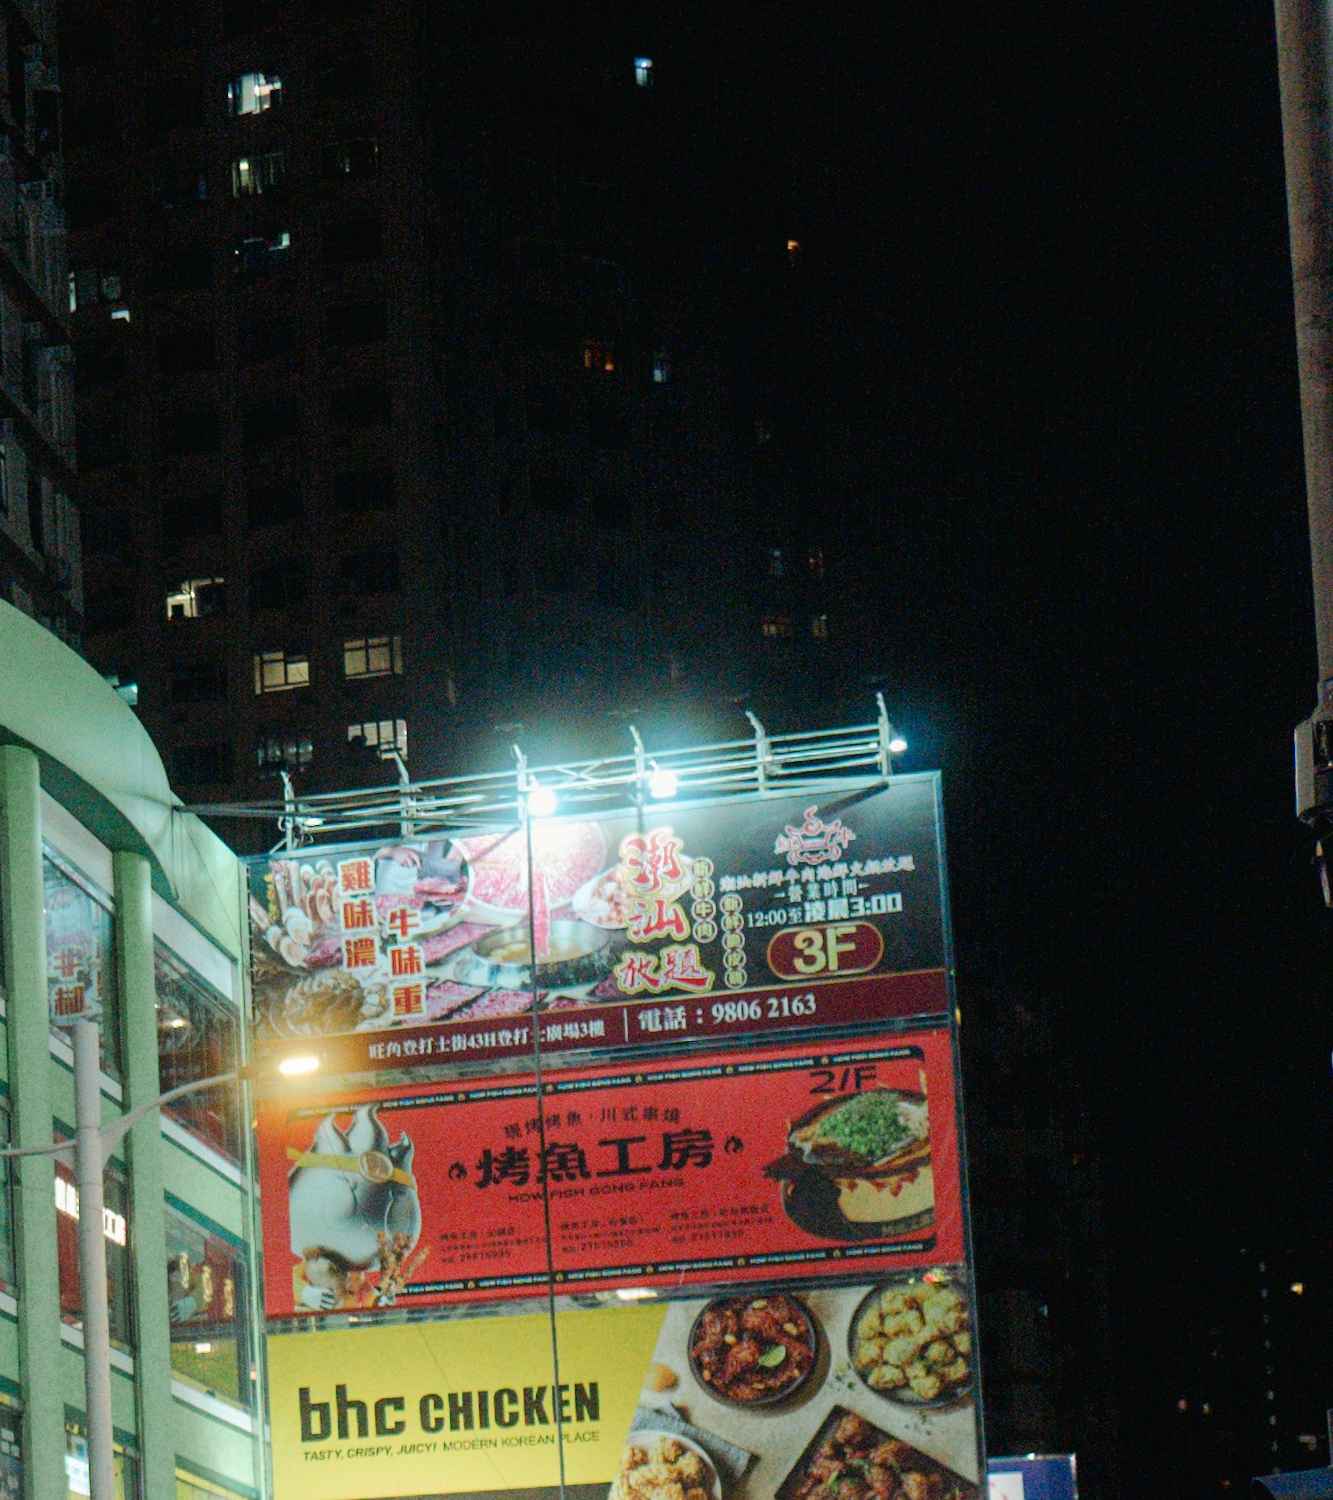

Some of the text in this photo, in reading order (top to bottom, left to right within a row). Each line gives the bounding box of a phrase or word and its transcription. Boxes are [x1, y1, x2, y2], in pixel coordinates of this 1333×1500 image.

[339, 858, 376, 970] 雞味濃
[386, 907, 423, 1017] 牛味重
[793, 926, 857, 975] 3F
[711, 999, 763, 1023] 9806
[768, 994, 817, 1017] 2163
[809, 1065, 878, 1095] 2/F
[476, 1128, 715, 1188] 烤魚工房
[548, 1188, 585, 1201] FISH
[639, 1178, 684, 1192] FANG
[299, 1381, 601, 1443] bhc CHICKEN
[304, 1431, 600, 1462] TASTY, CRISPY, JUICY! MODERN KOREAN PLACE
